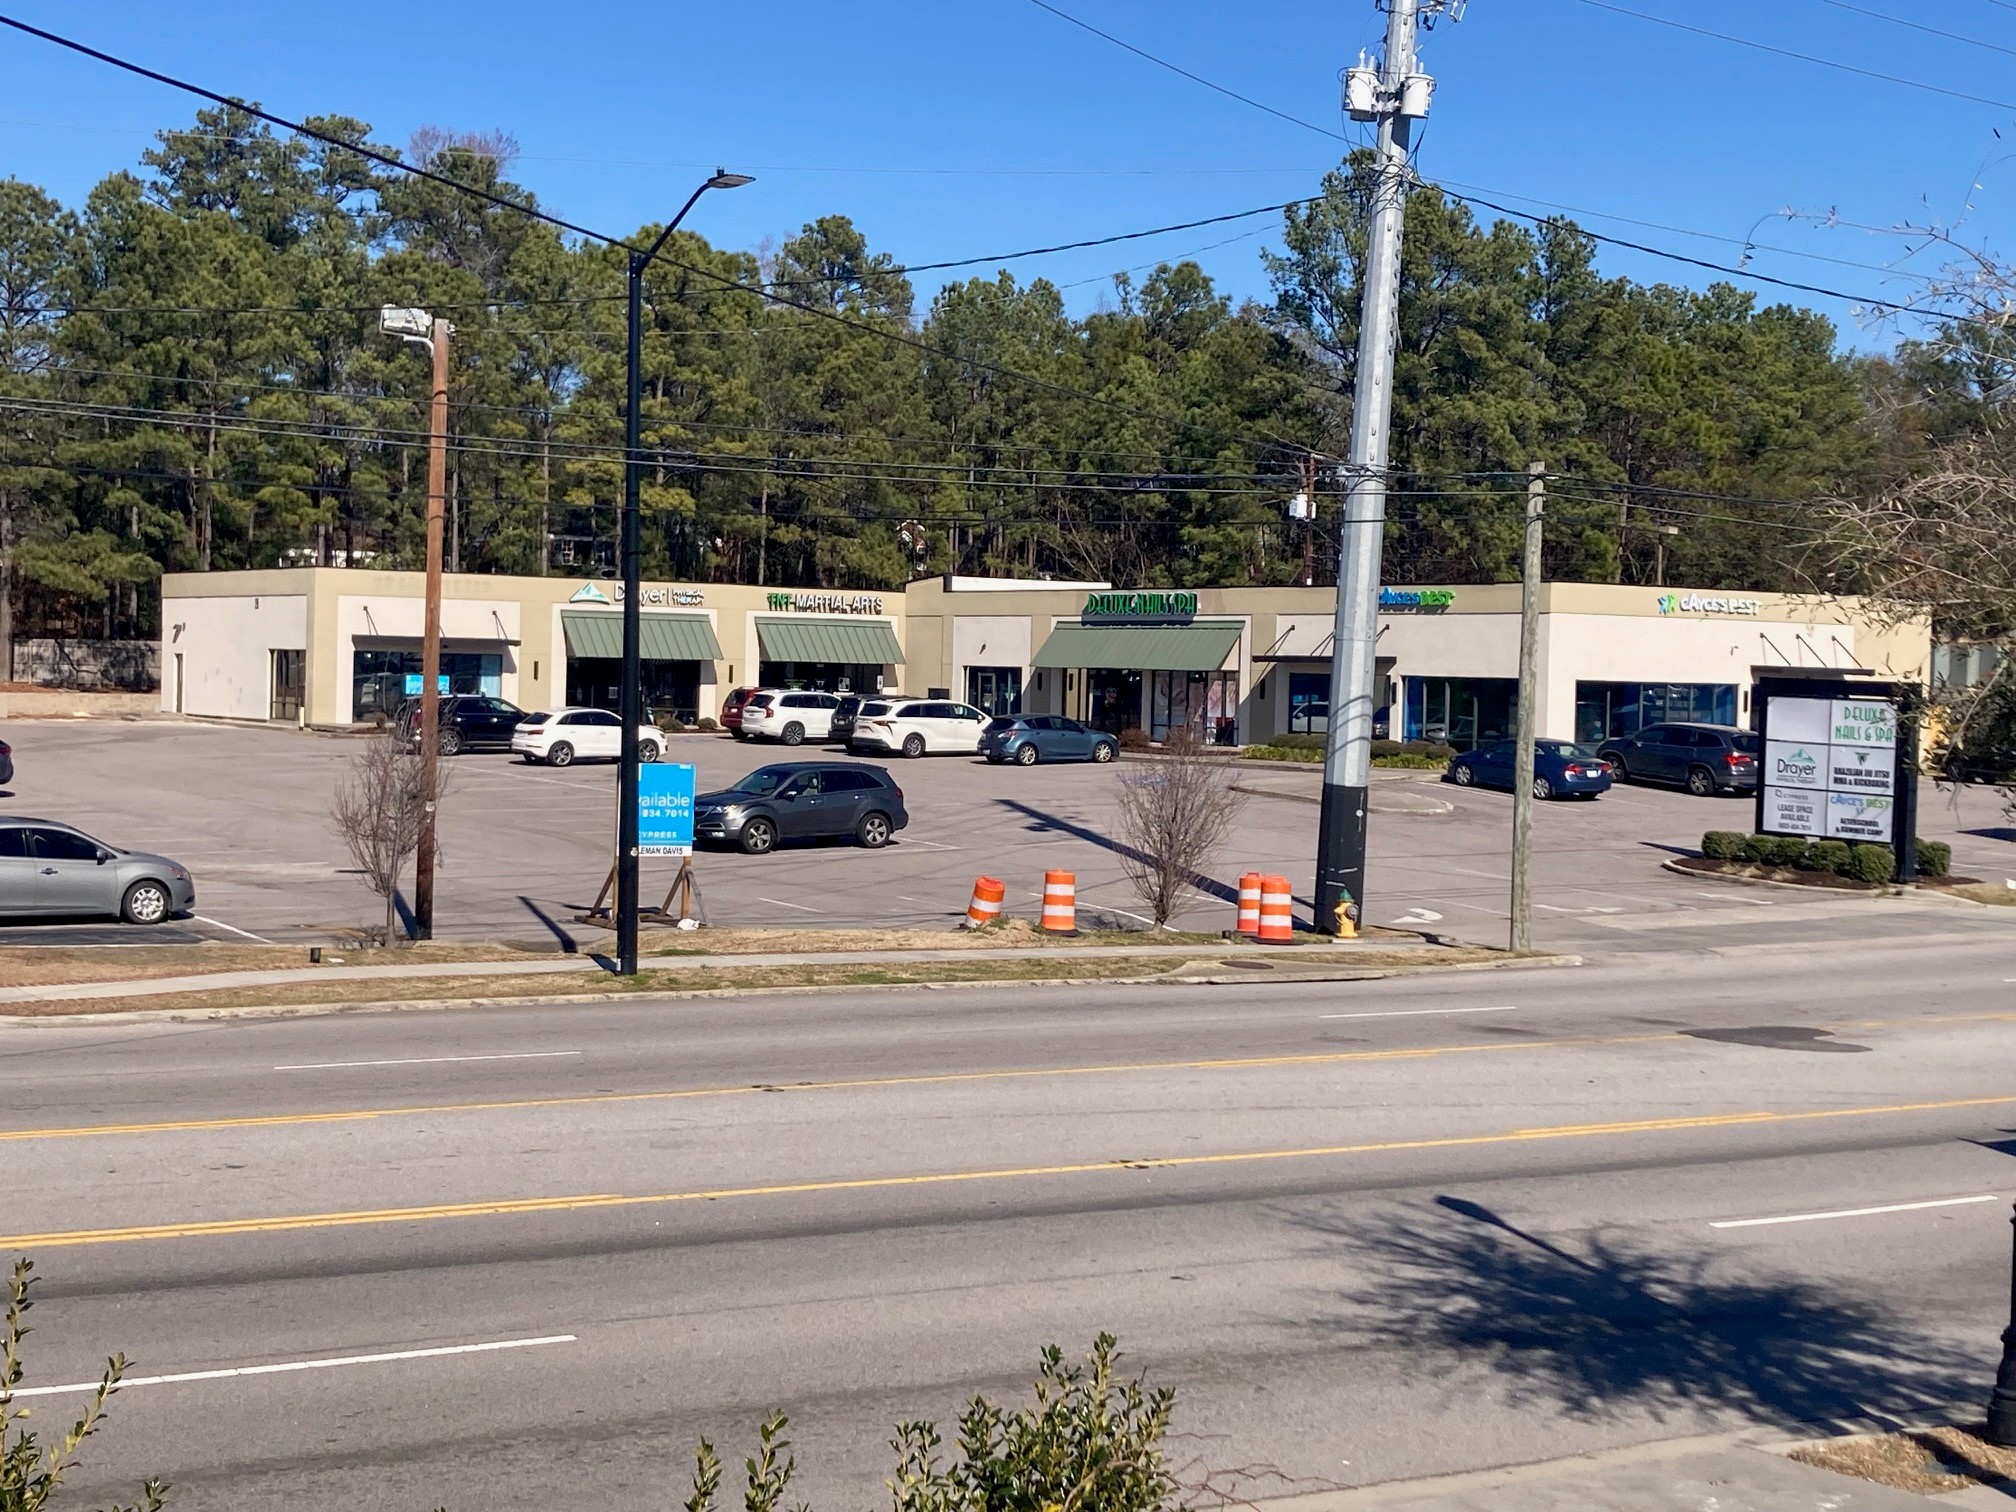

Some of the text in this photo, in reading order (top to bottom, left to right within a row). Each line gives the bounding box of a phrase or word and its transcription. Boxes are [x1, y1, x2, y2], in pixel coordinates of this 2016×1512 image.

[614, 582, 665, 605] Dyer
[1420, 590, 1455, 606] BEST
[796, 594, 850, 609] MARTIAL
[852, 595, 884, 611] ARTS
[1088, 592, 1198, 615] DELUXE NAILS SPA
[1728, 598, 1763, 615] BEST
[1835, 725, 1893, 742] NAILS & SPA
[1777, 758, 1816, 778] Drayer
[1777, 803, 1795, 812] LEASE
[1866, 798, 1891, 809] BEST
[663, 846, 683, 855] DAVIS
